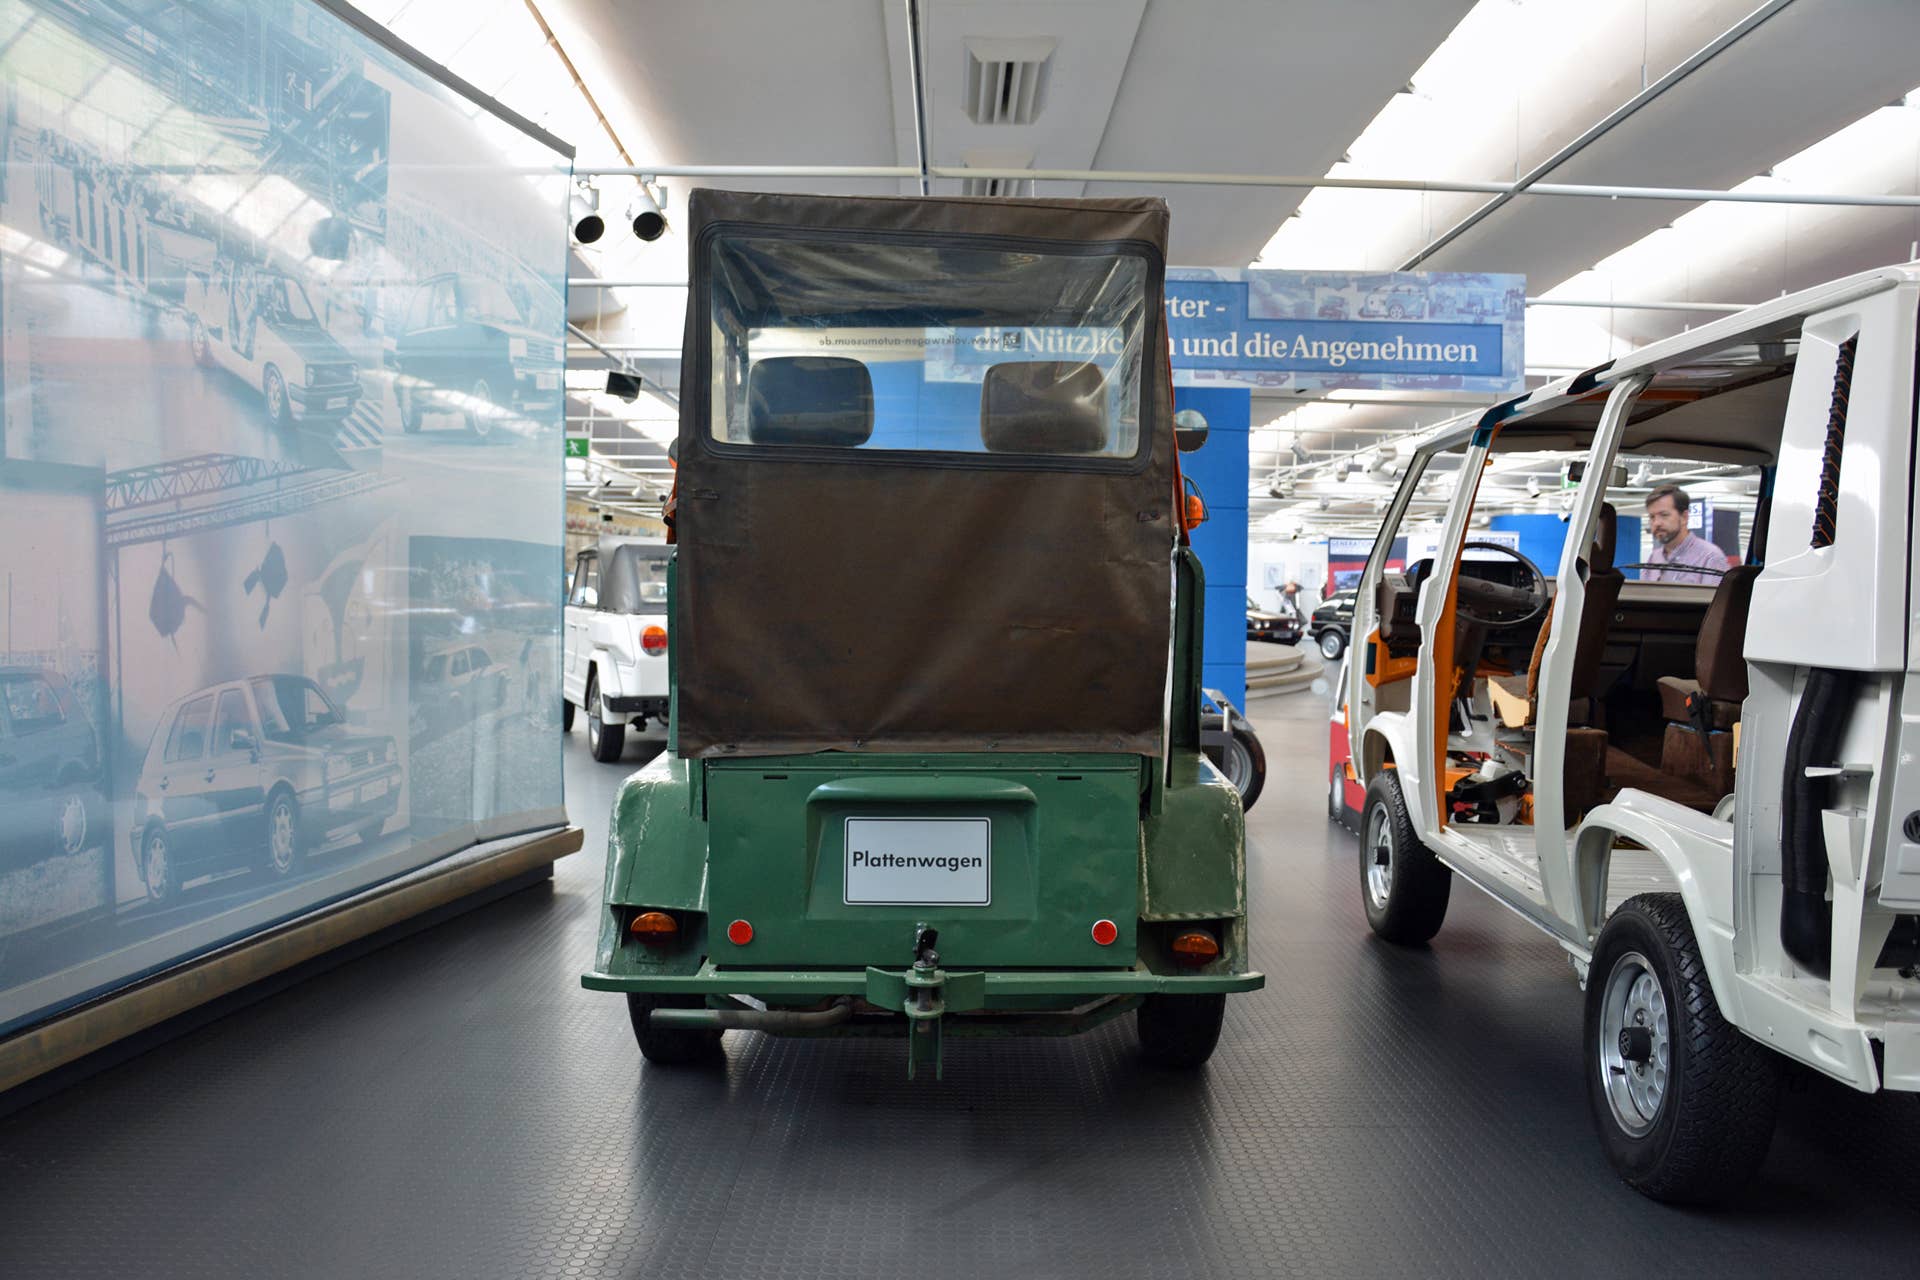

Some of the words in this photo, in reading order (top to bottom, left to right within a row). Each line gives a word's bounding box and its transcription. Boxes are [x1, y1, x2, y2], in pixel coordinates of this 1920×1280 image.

[1182, 331, 1239, 357] und
[1244, 332, 1288, 358] die
[1290, 334, 1479, 367] Angenehmen
[852, 850, 982, 872] Plattenwagen
